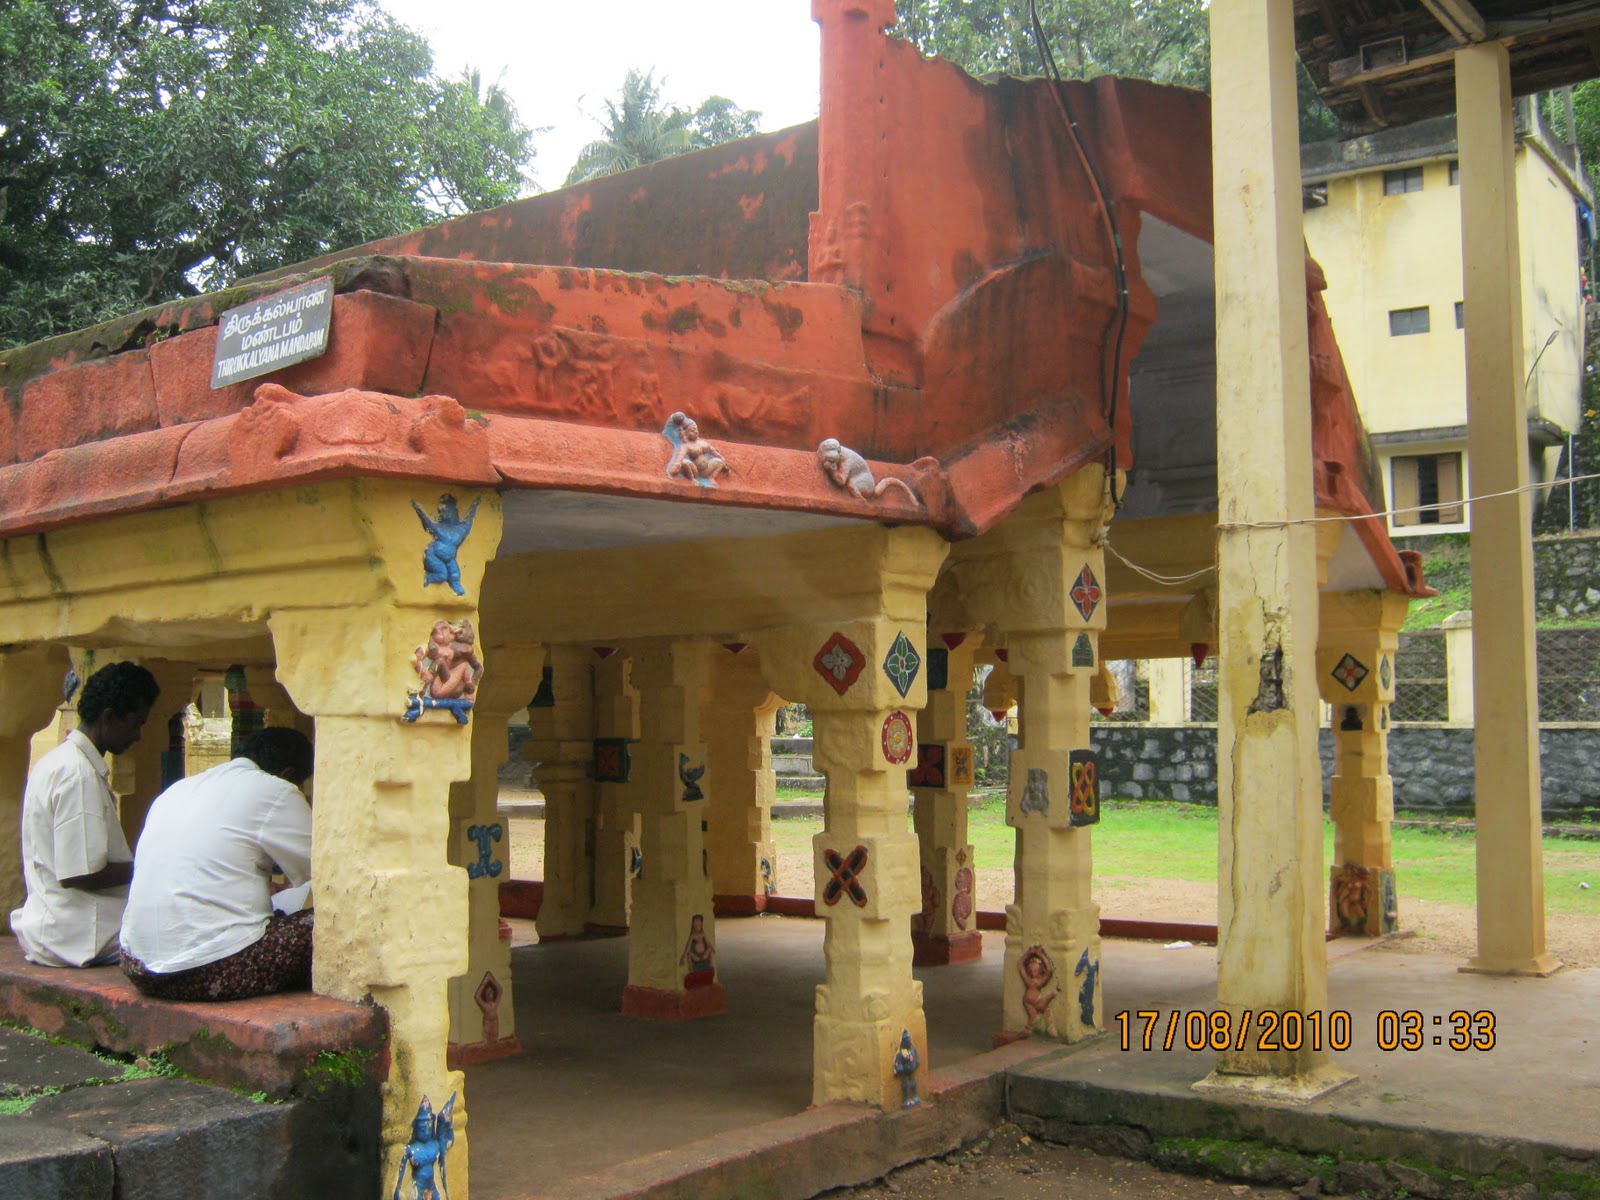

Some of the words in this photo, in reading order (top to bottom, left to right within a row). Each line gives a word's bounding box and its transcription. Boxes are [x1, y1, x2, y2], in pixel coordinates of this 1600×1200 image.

[223, 289, 327, 340] திருக்கல்யாண
[241, 312, 303, 351] மண்டபம்
[217, 343, 279, 379] THIRUKKALYANA
[279, 328, 325, 359] MANDAPAM
